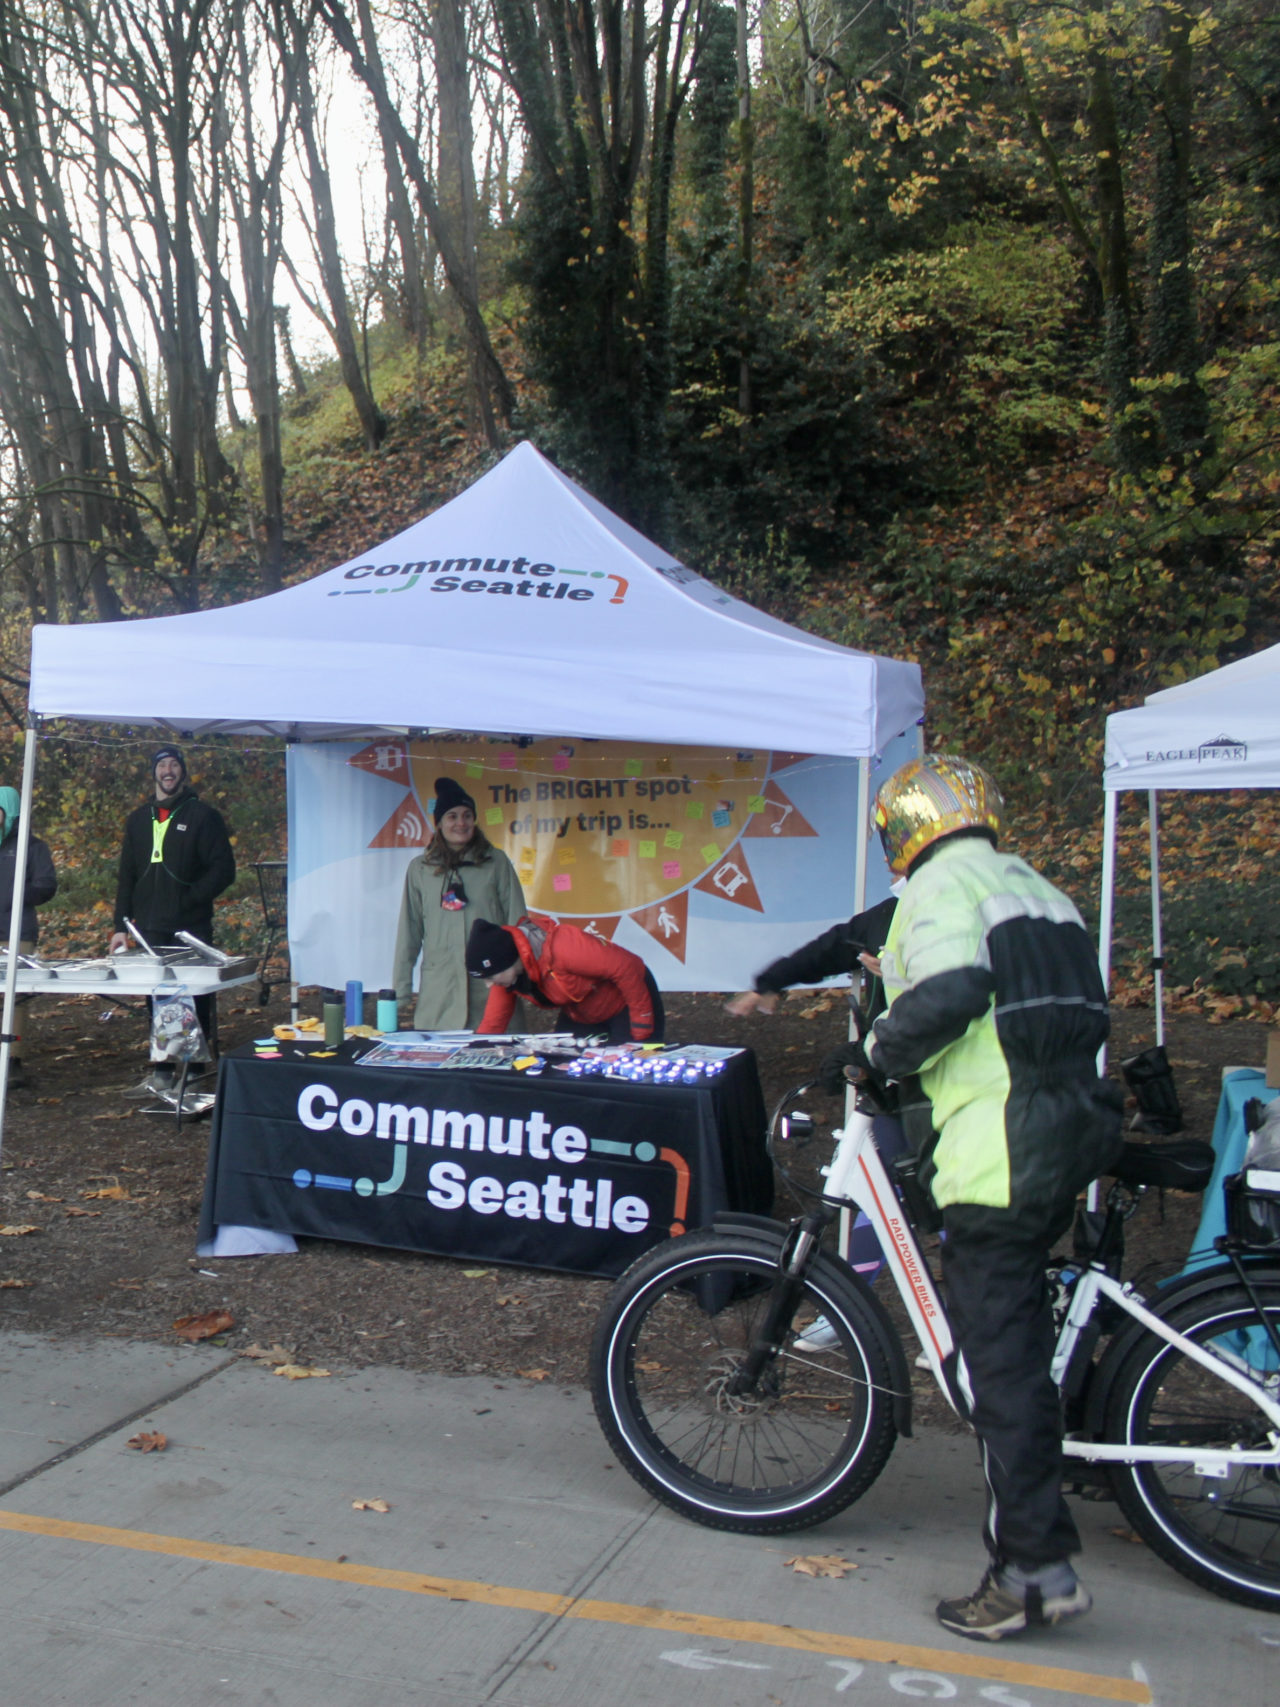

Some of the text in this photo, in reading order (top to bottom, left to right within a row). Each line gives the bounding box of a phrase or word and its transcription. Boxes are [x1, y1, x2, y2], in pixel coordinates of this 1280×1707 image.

[344, 557, 556, 580] Commute
[430, 576, 595, 601] Seattle
[1145, 748, 1243, 762] EAGLE PEAK
[488, 775, 692, 803] The BRIGHT spot
[510, 812, 533, 835] of
[536, 816, 571, 838] my
[577, 810, 623, 836] trip
[297, 1083, 591, 1163] Commute
[427, 1161, 650, 1234] Seattle
[889, 1217, 937, 1318] RAD POWER BIKES
